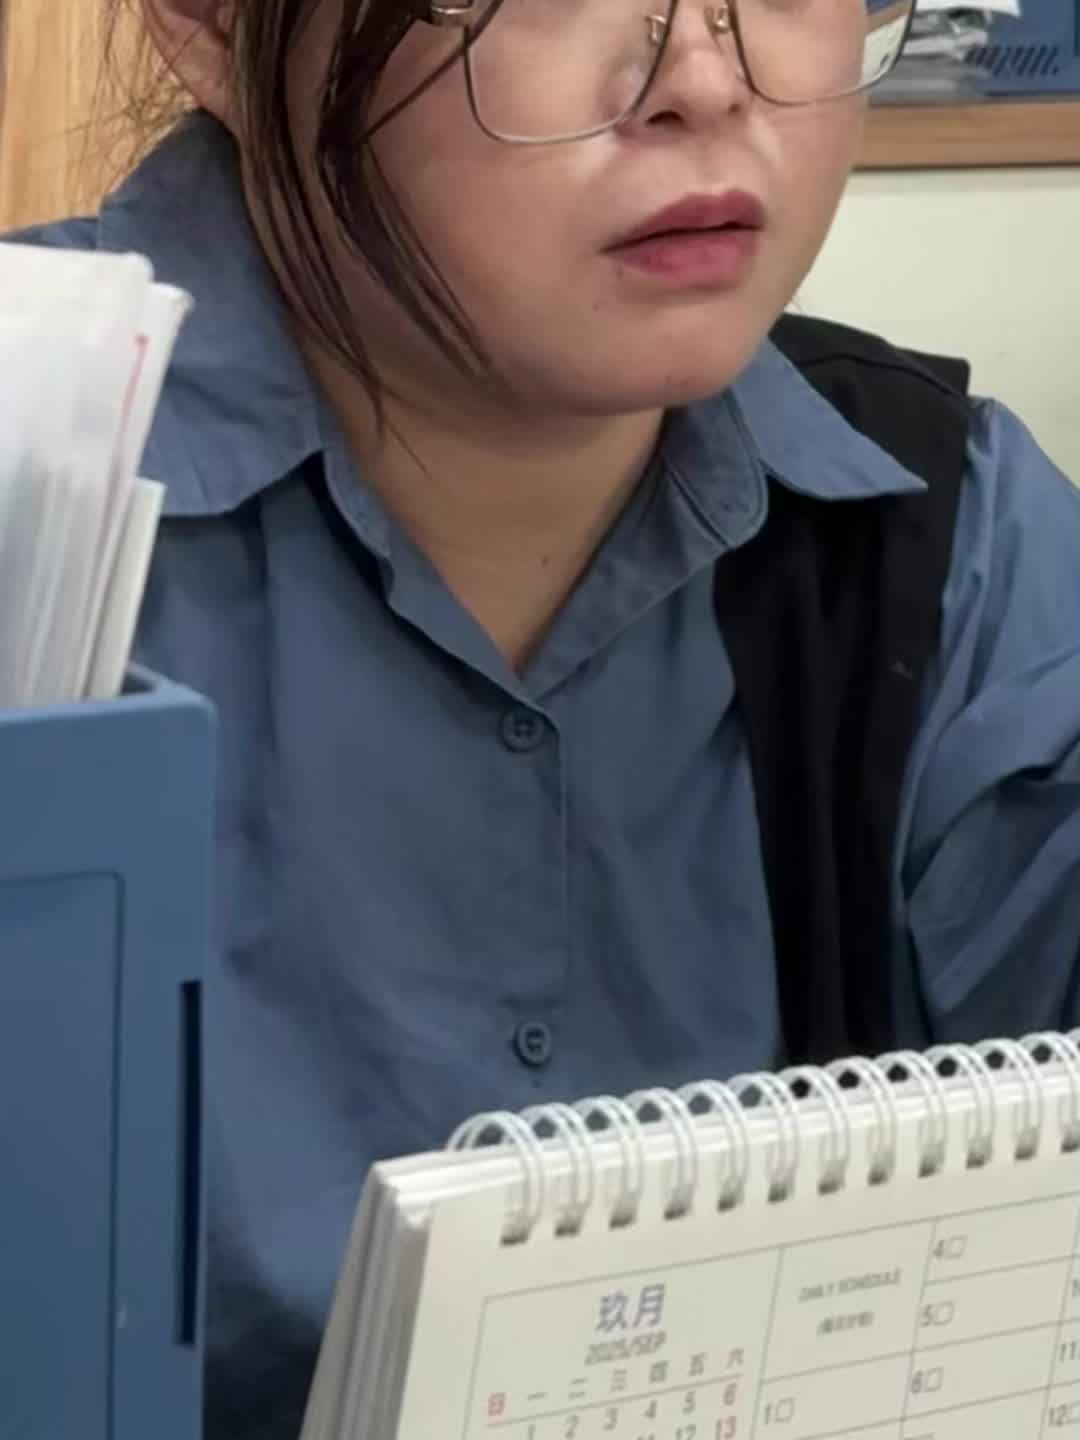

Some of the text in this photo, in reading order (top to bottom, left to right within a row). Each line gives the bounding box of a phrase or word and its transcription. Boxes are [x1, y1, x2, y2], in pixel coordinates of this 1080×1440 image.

[596, 1283, 665, 1332] 玖月
[920, 1304, 934, 1327] 5
[1059, 1339, 1077, 1364] 11
[487, 1392, 506, 1417] 日
[567, 1377, 588, 1400] 二
[610, 1368, 629, 1393] 三
[564, 1414, 580, 1440] 2
[603, 1408, 619, 1431] 3
[643, 1400, 658, 1420] 4
[682, 1390, 697, 1414] 5
[721, 1382, 738, 1407] 6
[1048, 1403, 1069, 1428] 12
[714, 1415, 738, 1440] 13
